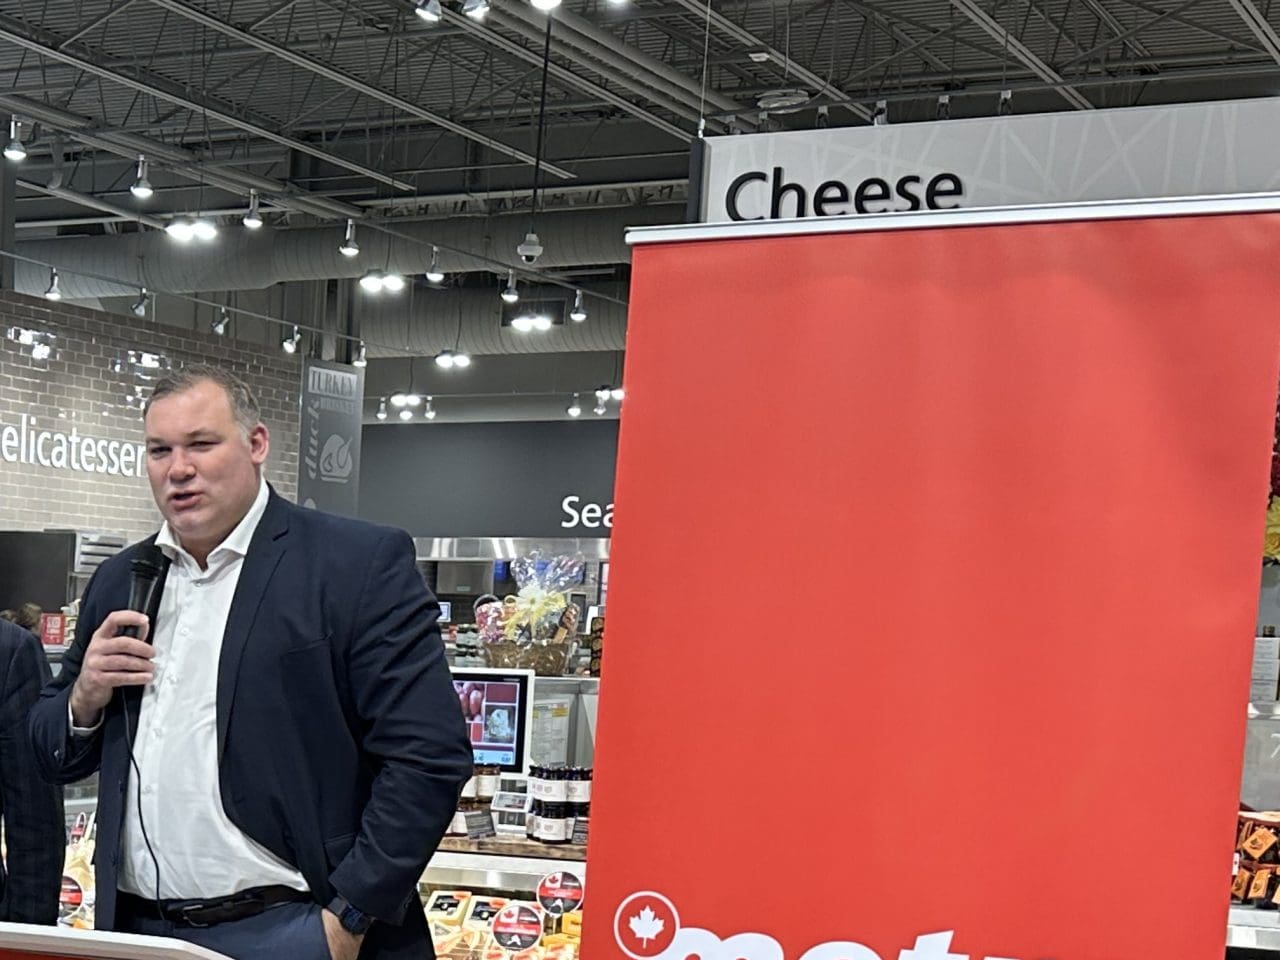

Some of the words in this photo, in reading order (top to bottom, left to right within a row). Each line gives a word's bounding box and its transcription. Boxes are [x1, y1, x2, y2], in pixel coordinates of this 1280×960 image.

[725, 166, 964, 222] Cheese
[311, 370, 353, 397] TURKEY
[305, 399, 320, 480] duck
[561, 495, 615, 528] Sea
